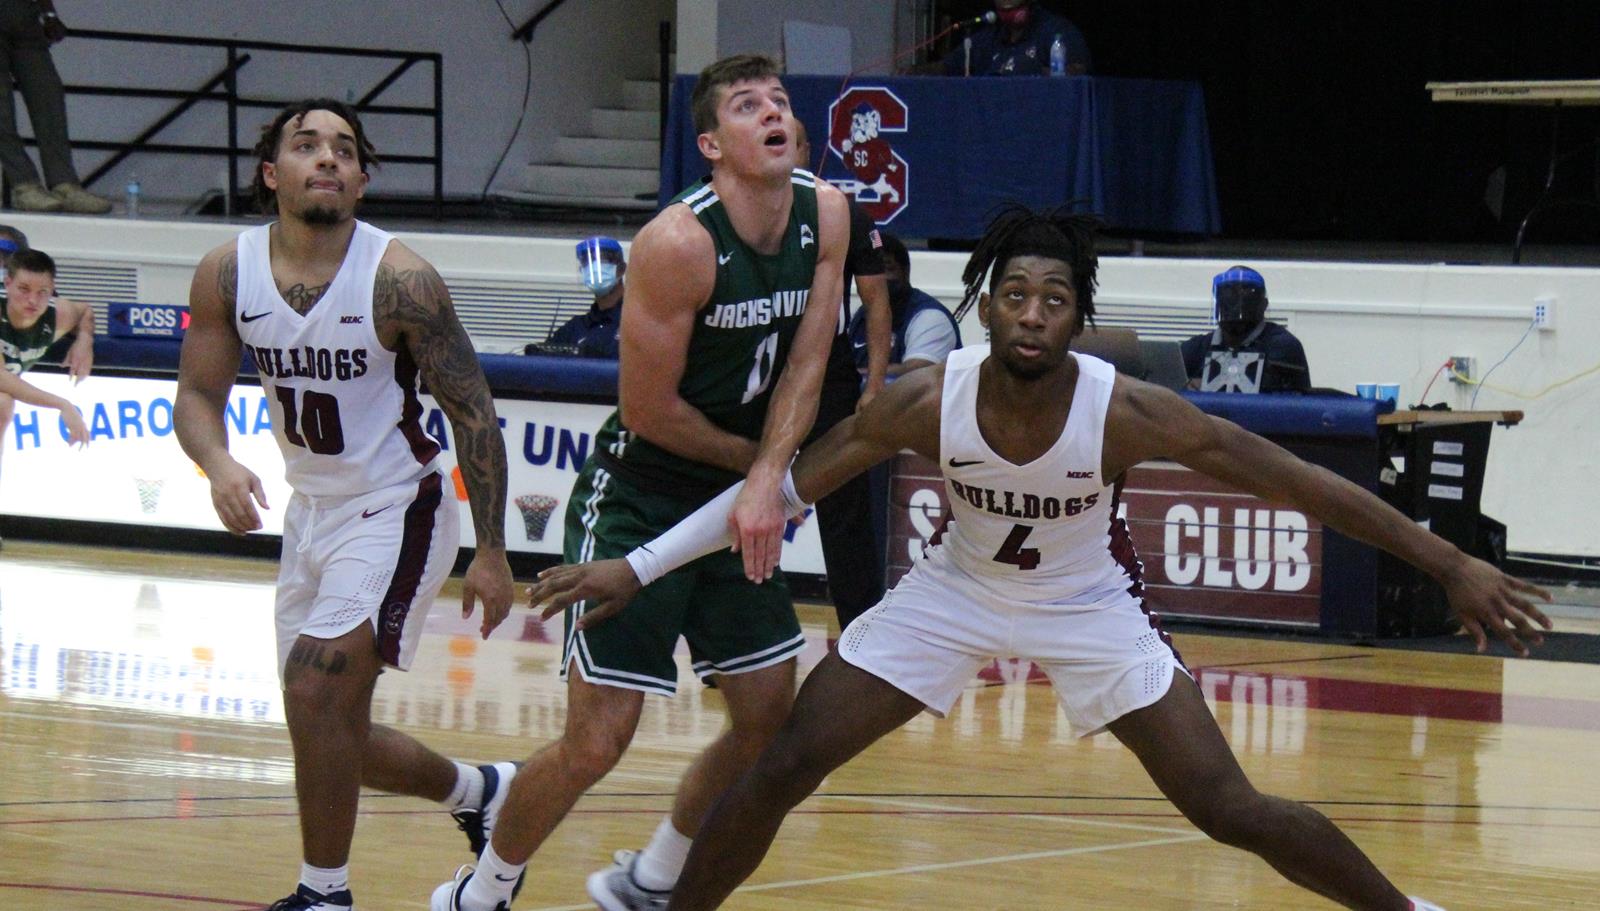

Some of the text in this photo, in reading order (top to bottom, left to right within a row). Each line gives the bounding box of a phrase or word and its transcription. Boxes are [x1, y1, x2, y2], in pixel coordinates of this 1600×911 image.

[854, 150, 868, 167] SC
[130, 307, 176, 328] POSS
[275, 385, 345, 455] 10
[992, 524, 1041, 571] 4
[1164, 503, 1312, 592] CLUB
